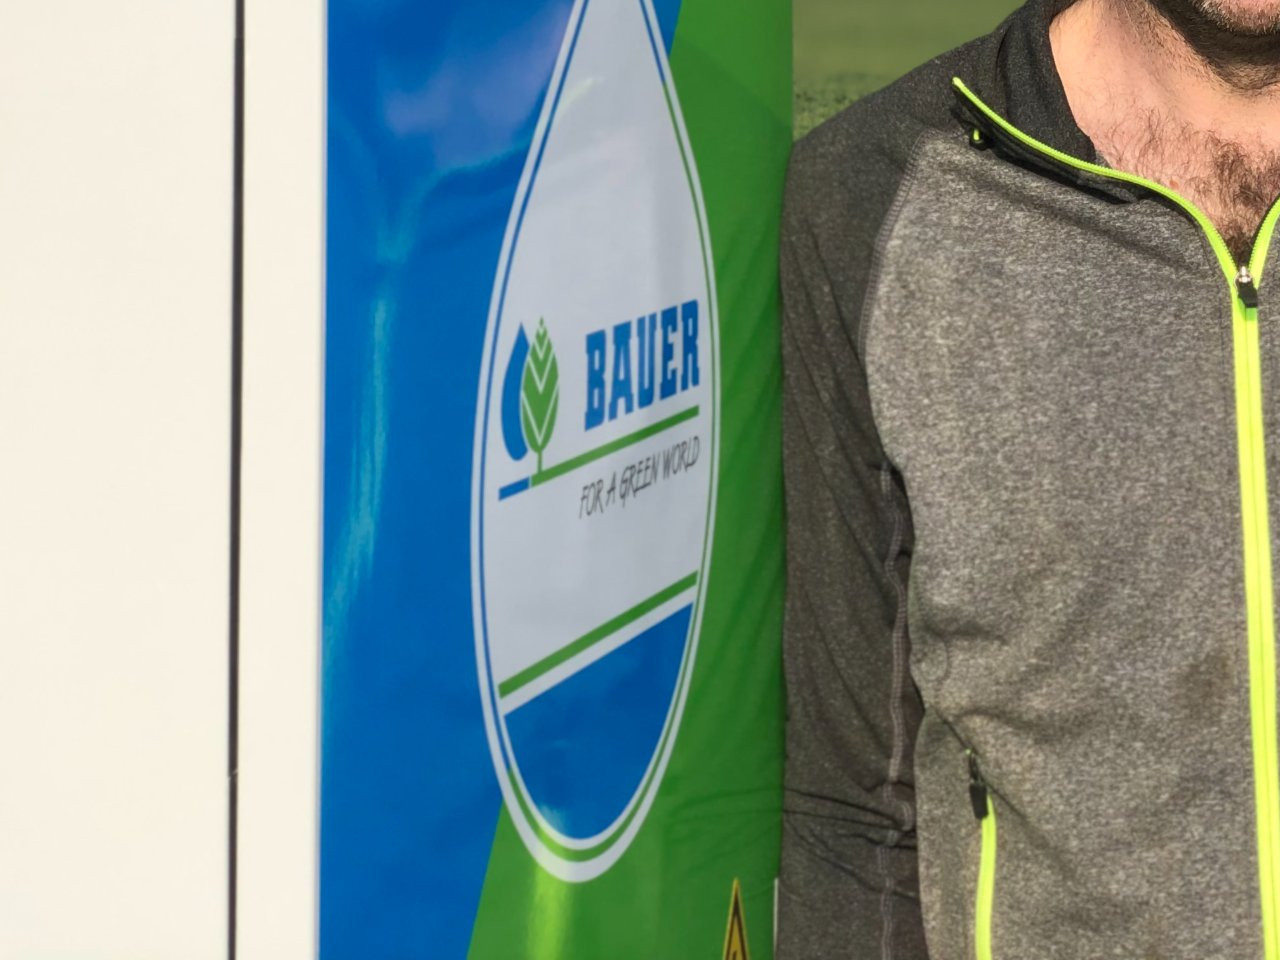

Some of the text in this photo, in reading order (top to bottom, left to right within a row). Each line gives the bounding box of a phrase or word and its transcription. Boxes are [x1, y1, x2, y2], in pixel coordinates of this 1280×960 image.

[584, 299, 700, 432] BAUER
[579, 435, 701, 519] FOR A GREEN WORLD
